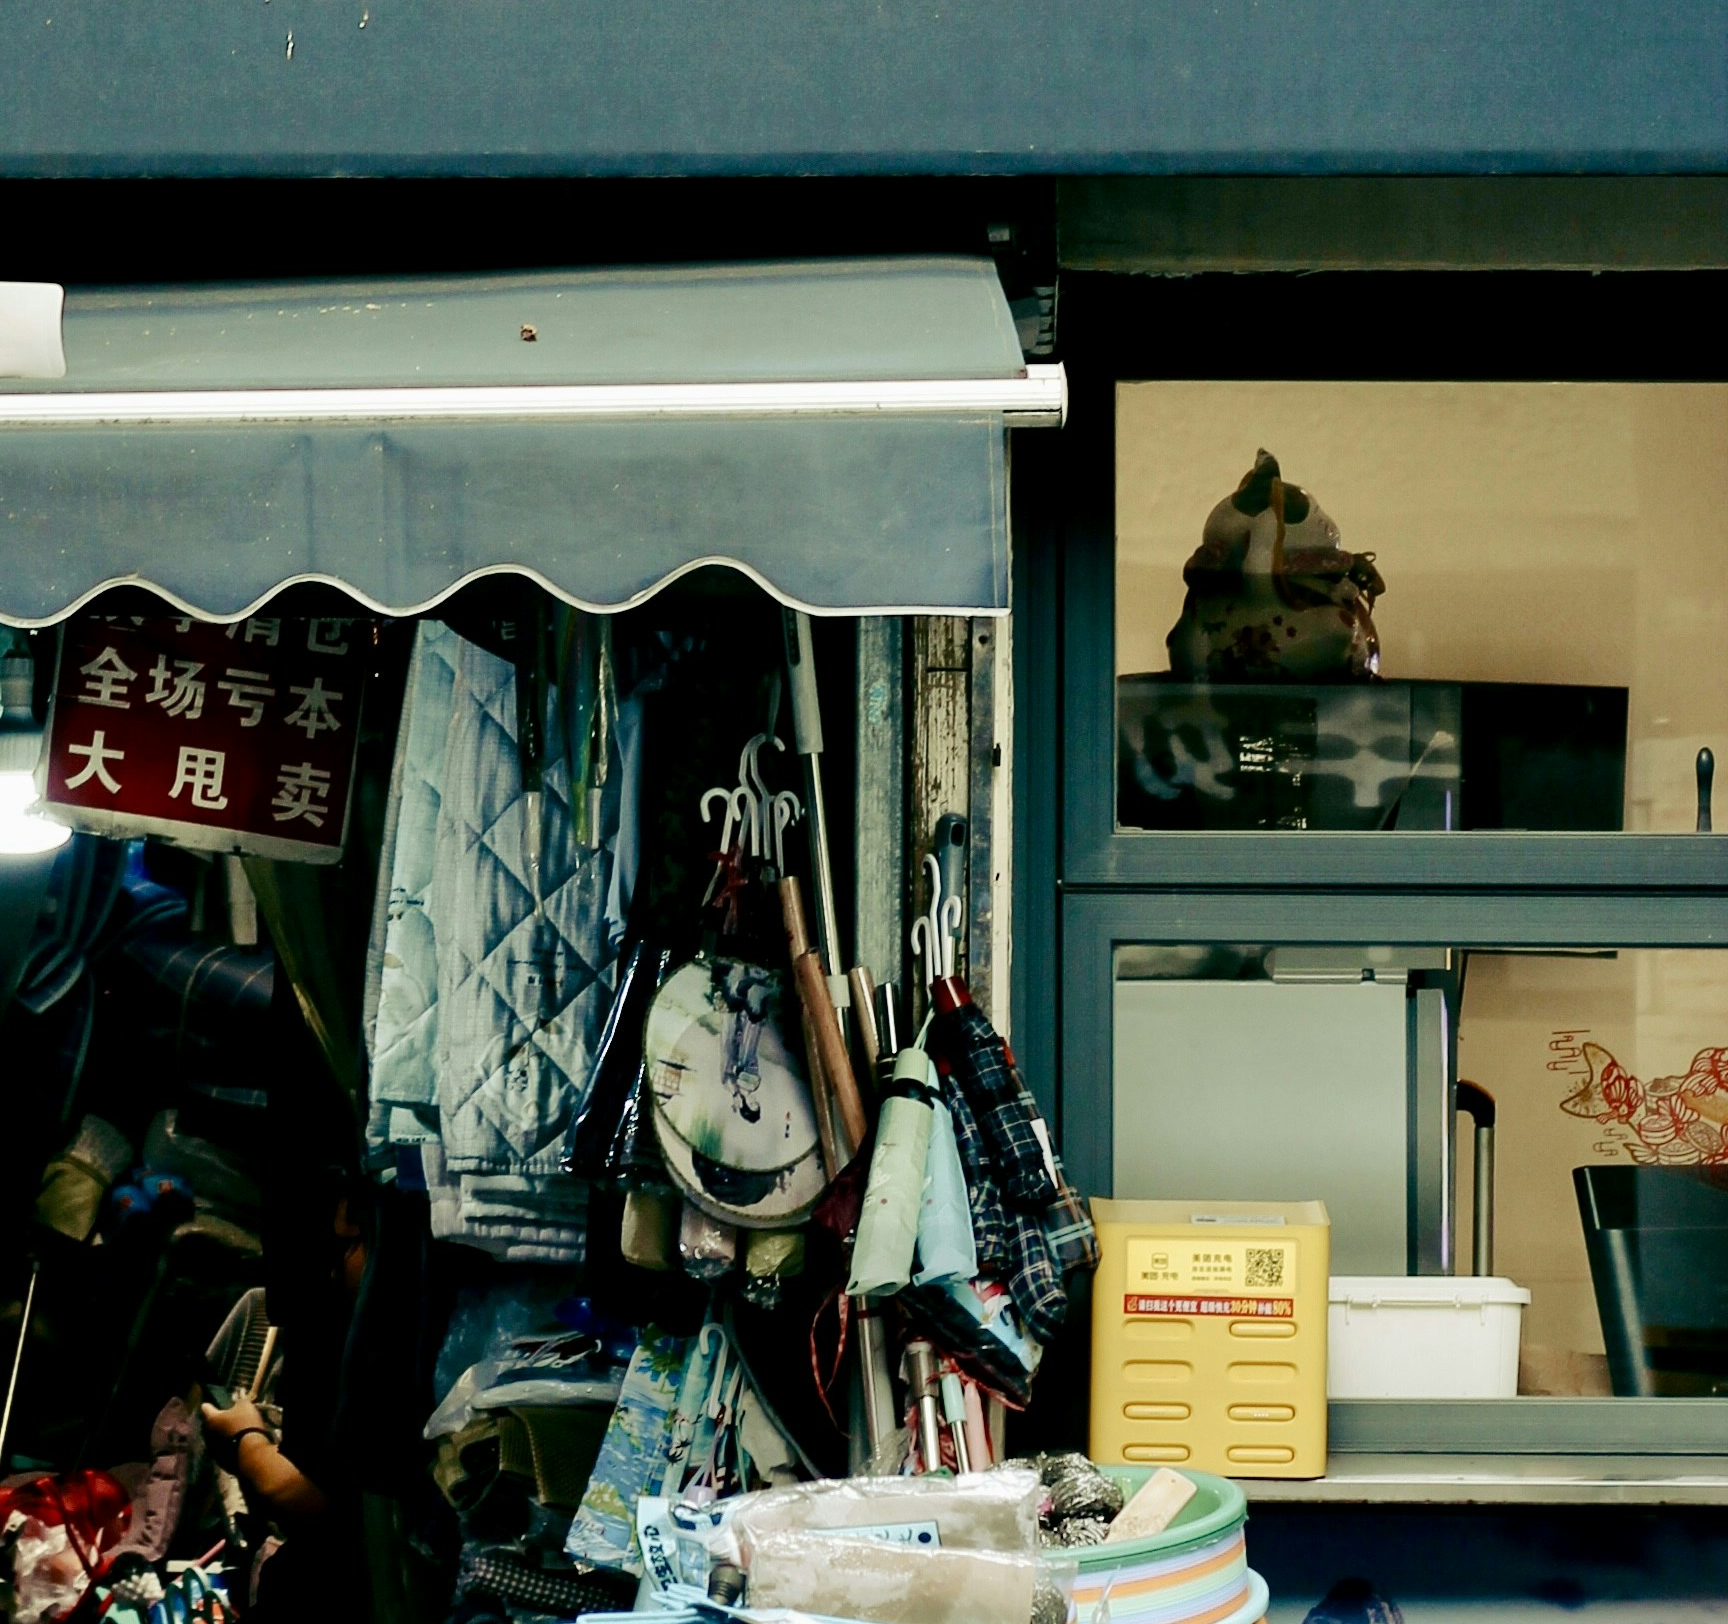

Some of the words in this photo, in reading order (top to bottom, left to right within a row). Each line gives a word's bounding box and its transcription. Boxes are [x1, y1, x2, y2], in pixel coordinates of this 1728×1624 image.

[77, 646, 344, 740] 全场亏本
[64, 730, 332, 828] 大甩卖
